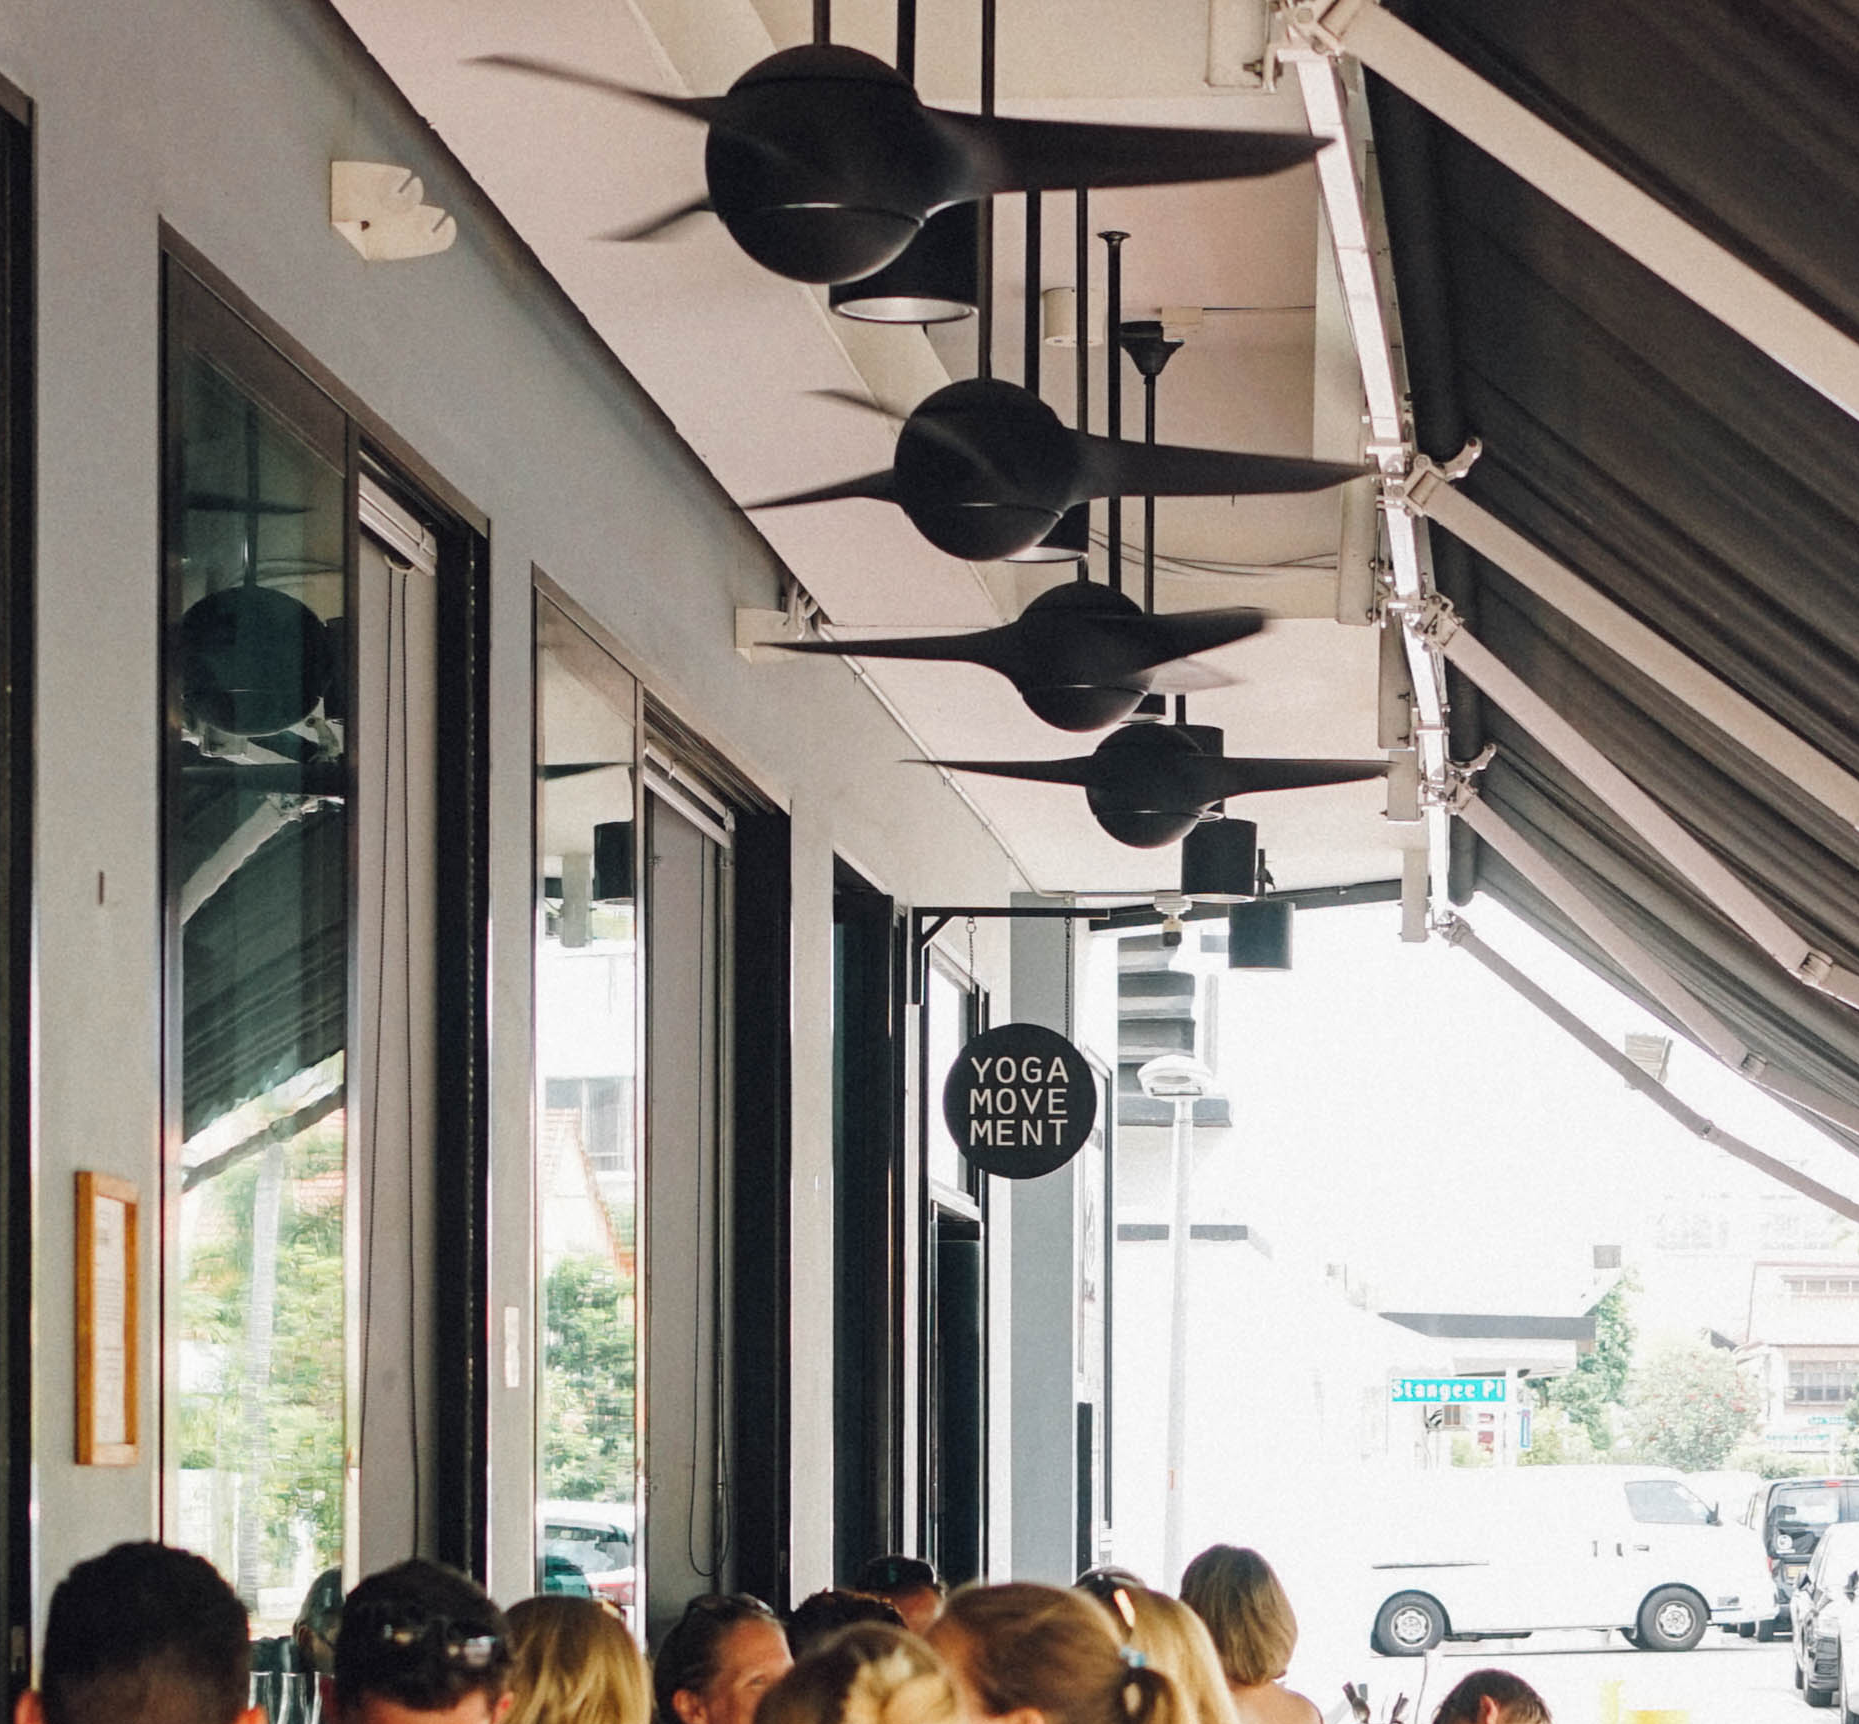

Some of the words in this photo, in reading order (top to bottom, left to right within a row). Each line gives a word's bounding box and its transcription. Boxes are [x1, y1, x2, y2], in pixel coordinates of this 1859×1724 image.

[970, 1056, 1069, 1083] YOGA
[968, 1087, 1068, 1115] MOVE
[969, 1119, 1069, 1146] MENT
[1391, 1379, 1476, 1401] Stangee
[1482, 1379, 1503, 1398] Pl
